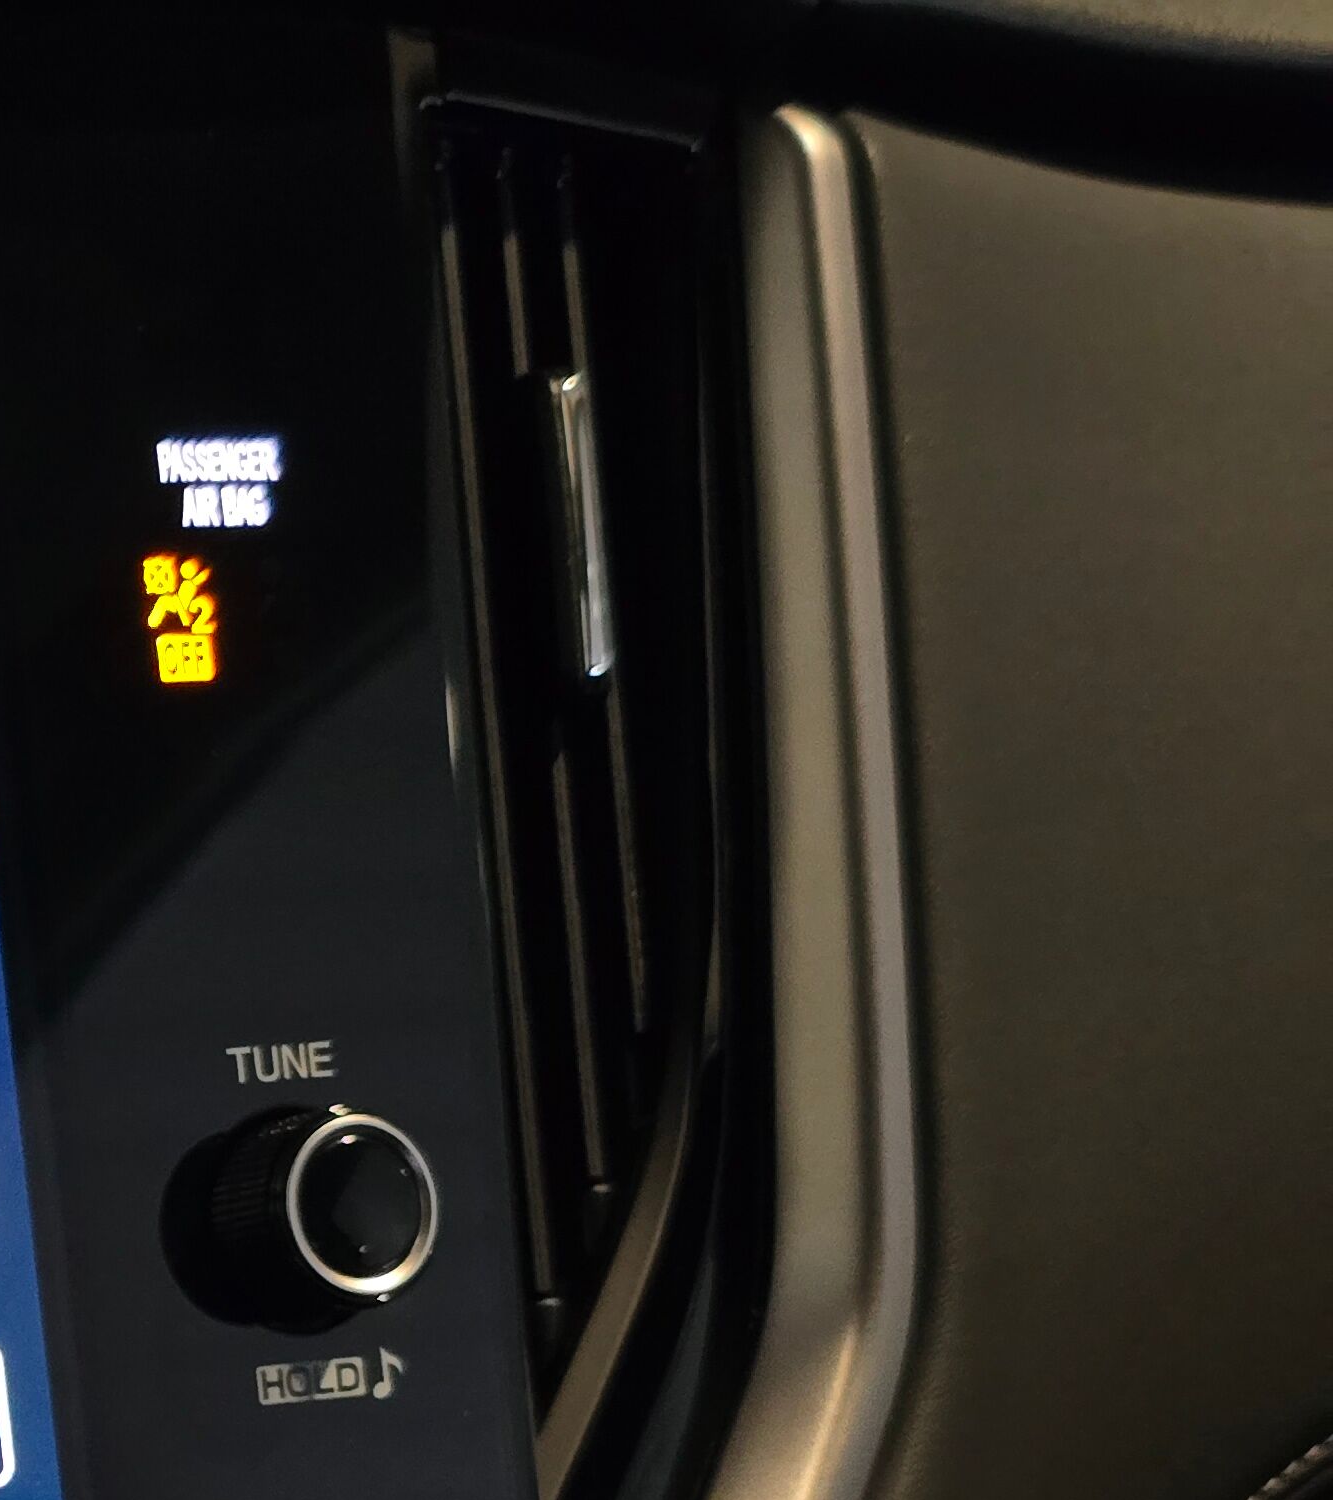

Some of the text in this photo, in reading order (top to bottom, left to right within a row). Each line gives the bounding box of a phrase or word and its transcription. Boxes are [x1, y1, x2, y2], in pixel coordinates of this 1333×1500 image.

[156, 437, 281, 483] PASSENGER
[183, 485, 222, 527] AIR
[225, 1040, 338, 1084] TUNE
[259, 1361, 361, 1400] HOLD
